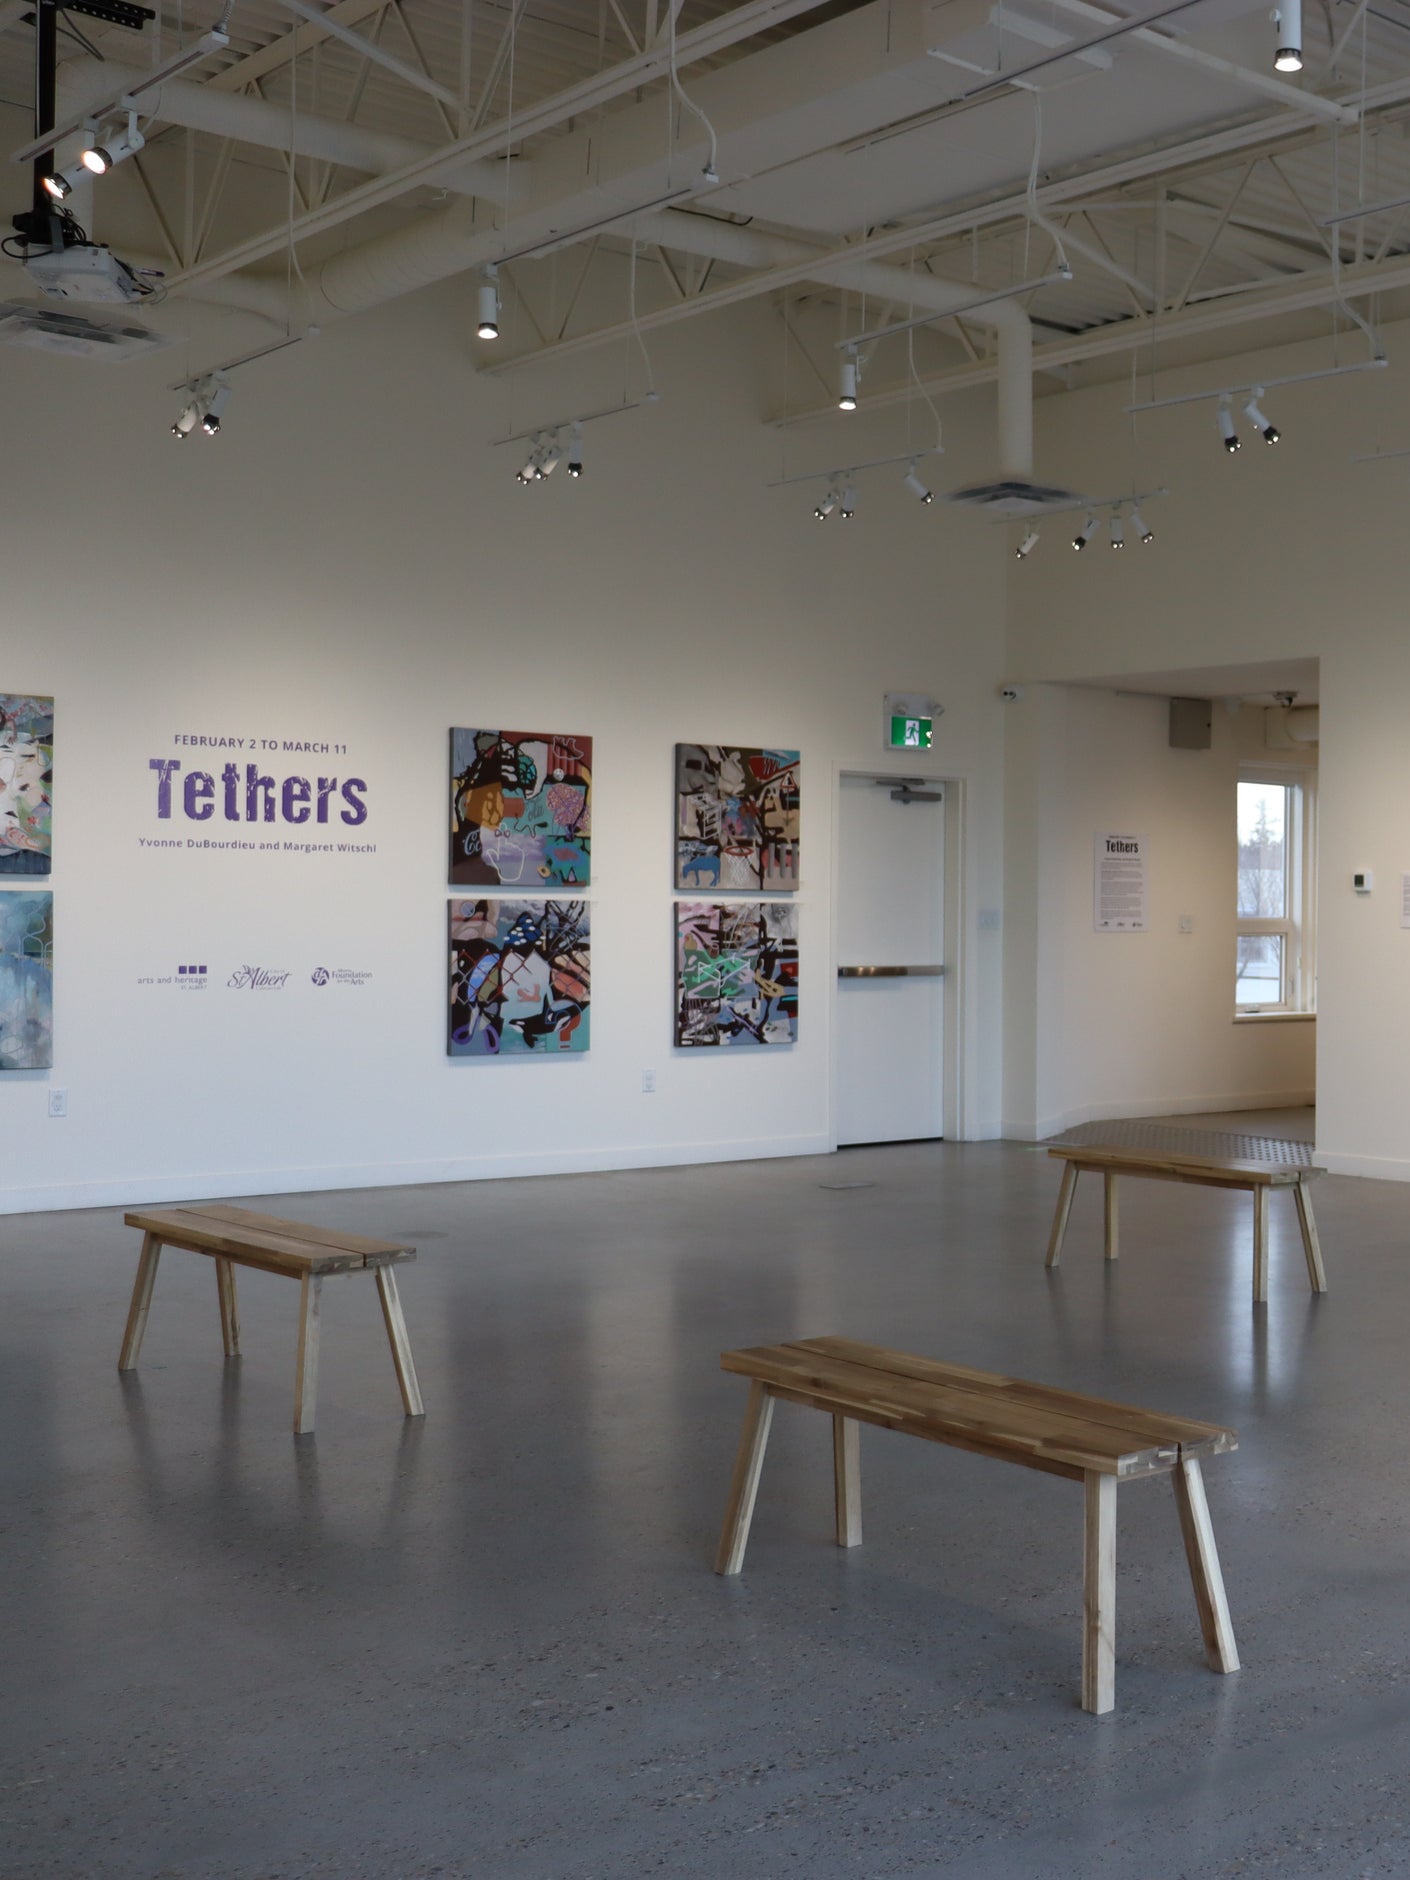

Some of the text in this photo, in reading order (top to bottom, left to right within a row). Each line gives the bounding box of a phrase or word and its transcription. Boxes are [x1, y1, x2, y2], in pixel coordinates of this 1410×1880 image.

[174, 734, 347, 754] FEBRUARY 2 TO MARCH 11
[149, 758, 368, 826] Tethers
[139, 837, 183, 848] Yvonne
[187, 839, 256, 850] DuBourdieu
[259, 841, 280, 851] and
[283, 842, 334, 854] Margaret
[1106, 839, 1139, 853] Tethers
[137, 976, 208, 985] arts and heritage
[332, 970, 373, 979] Foundation
